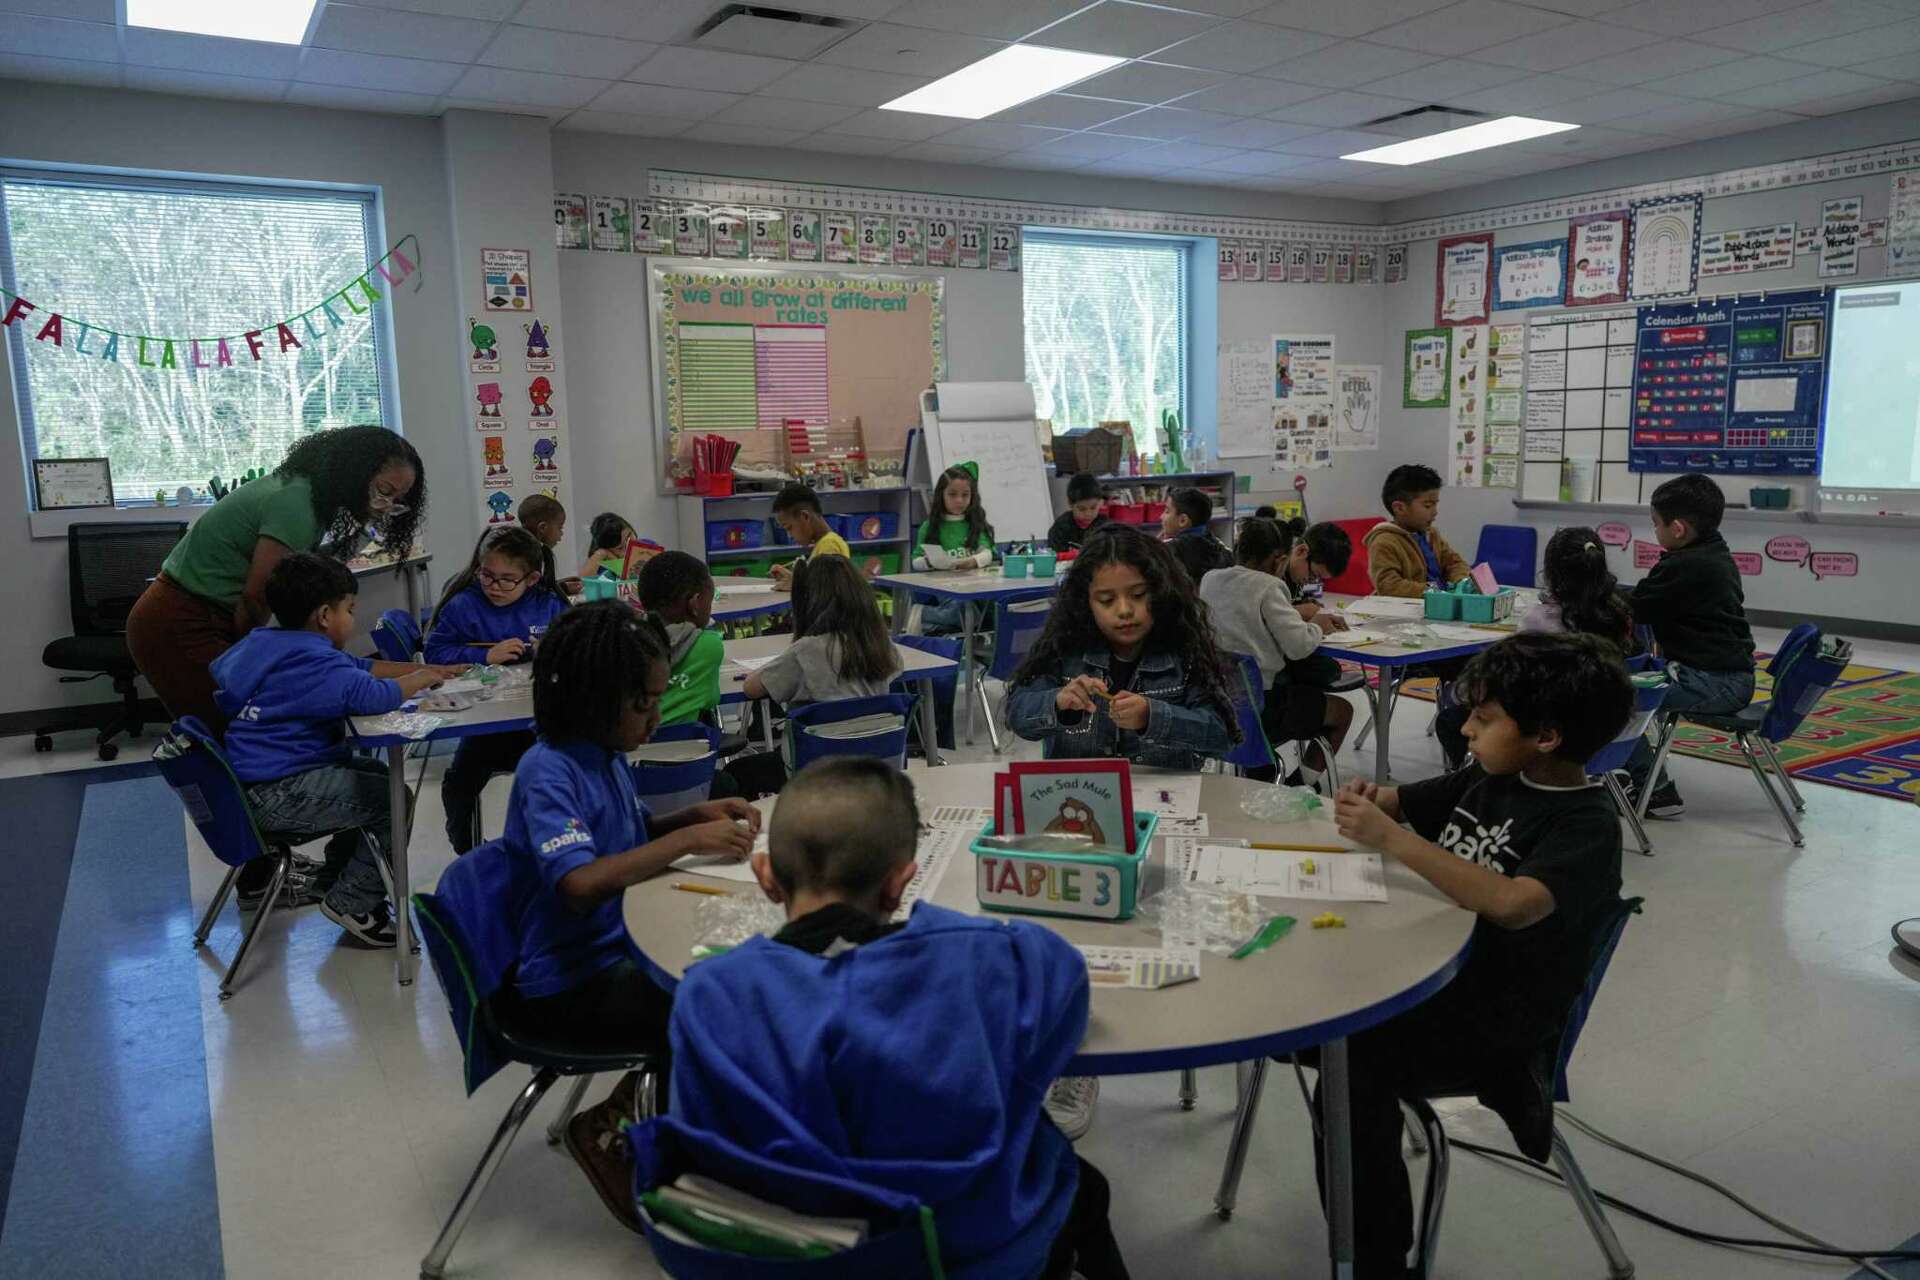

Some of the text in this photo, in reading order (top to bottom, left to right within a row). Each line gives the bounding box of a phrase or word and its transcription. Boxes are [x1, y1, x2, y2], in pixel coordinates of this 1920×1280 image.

[555, 209, 566, 226] 0
[598, 212, 608, 228] 1
[640, 214, 651, 230] 2
[679, 217, 689, 233] 3
[717, 222, 728, 235] 4
[756, 221, 766, 237] 5
[792, 223, 802, 239] 6
[829, 227, 838, 242] 7
[930, 223, 947, 238] 10
[864, 229, 874, 244] 8
[897, 229, 906, 244] 9
[962, 234, 978, 248] 11
[993, 236, 1009, 251] 12
[1221, 250, 1234, 263] 13
[1245, 251, 1257, 264] 14
[1269, 251, 1281, 264] 15
[1292, 253, 1304, 265] 16
[1315, 252, 1327, 264] 17
[1337, 253, 1348, 265] 18
[1359, 254, 1370, 266] 19
[1388, 253, 1401, 265] 20
[720, 288, 744, 307] all
[751, 289, 800, 309] grow
[805, 291, 826, 308] at
[831, 292, 908, 312] different
[776, 306, 829, 324] rates
[1645, 310, 1726, 326] Calendar Math
[1030, 782, 1054, 801] The
[1082, 780, 1113, 801] Mule
[982, 858, 1112, 906] TABLE 3
